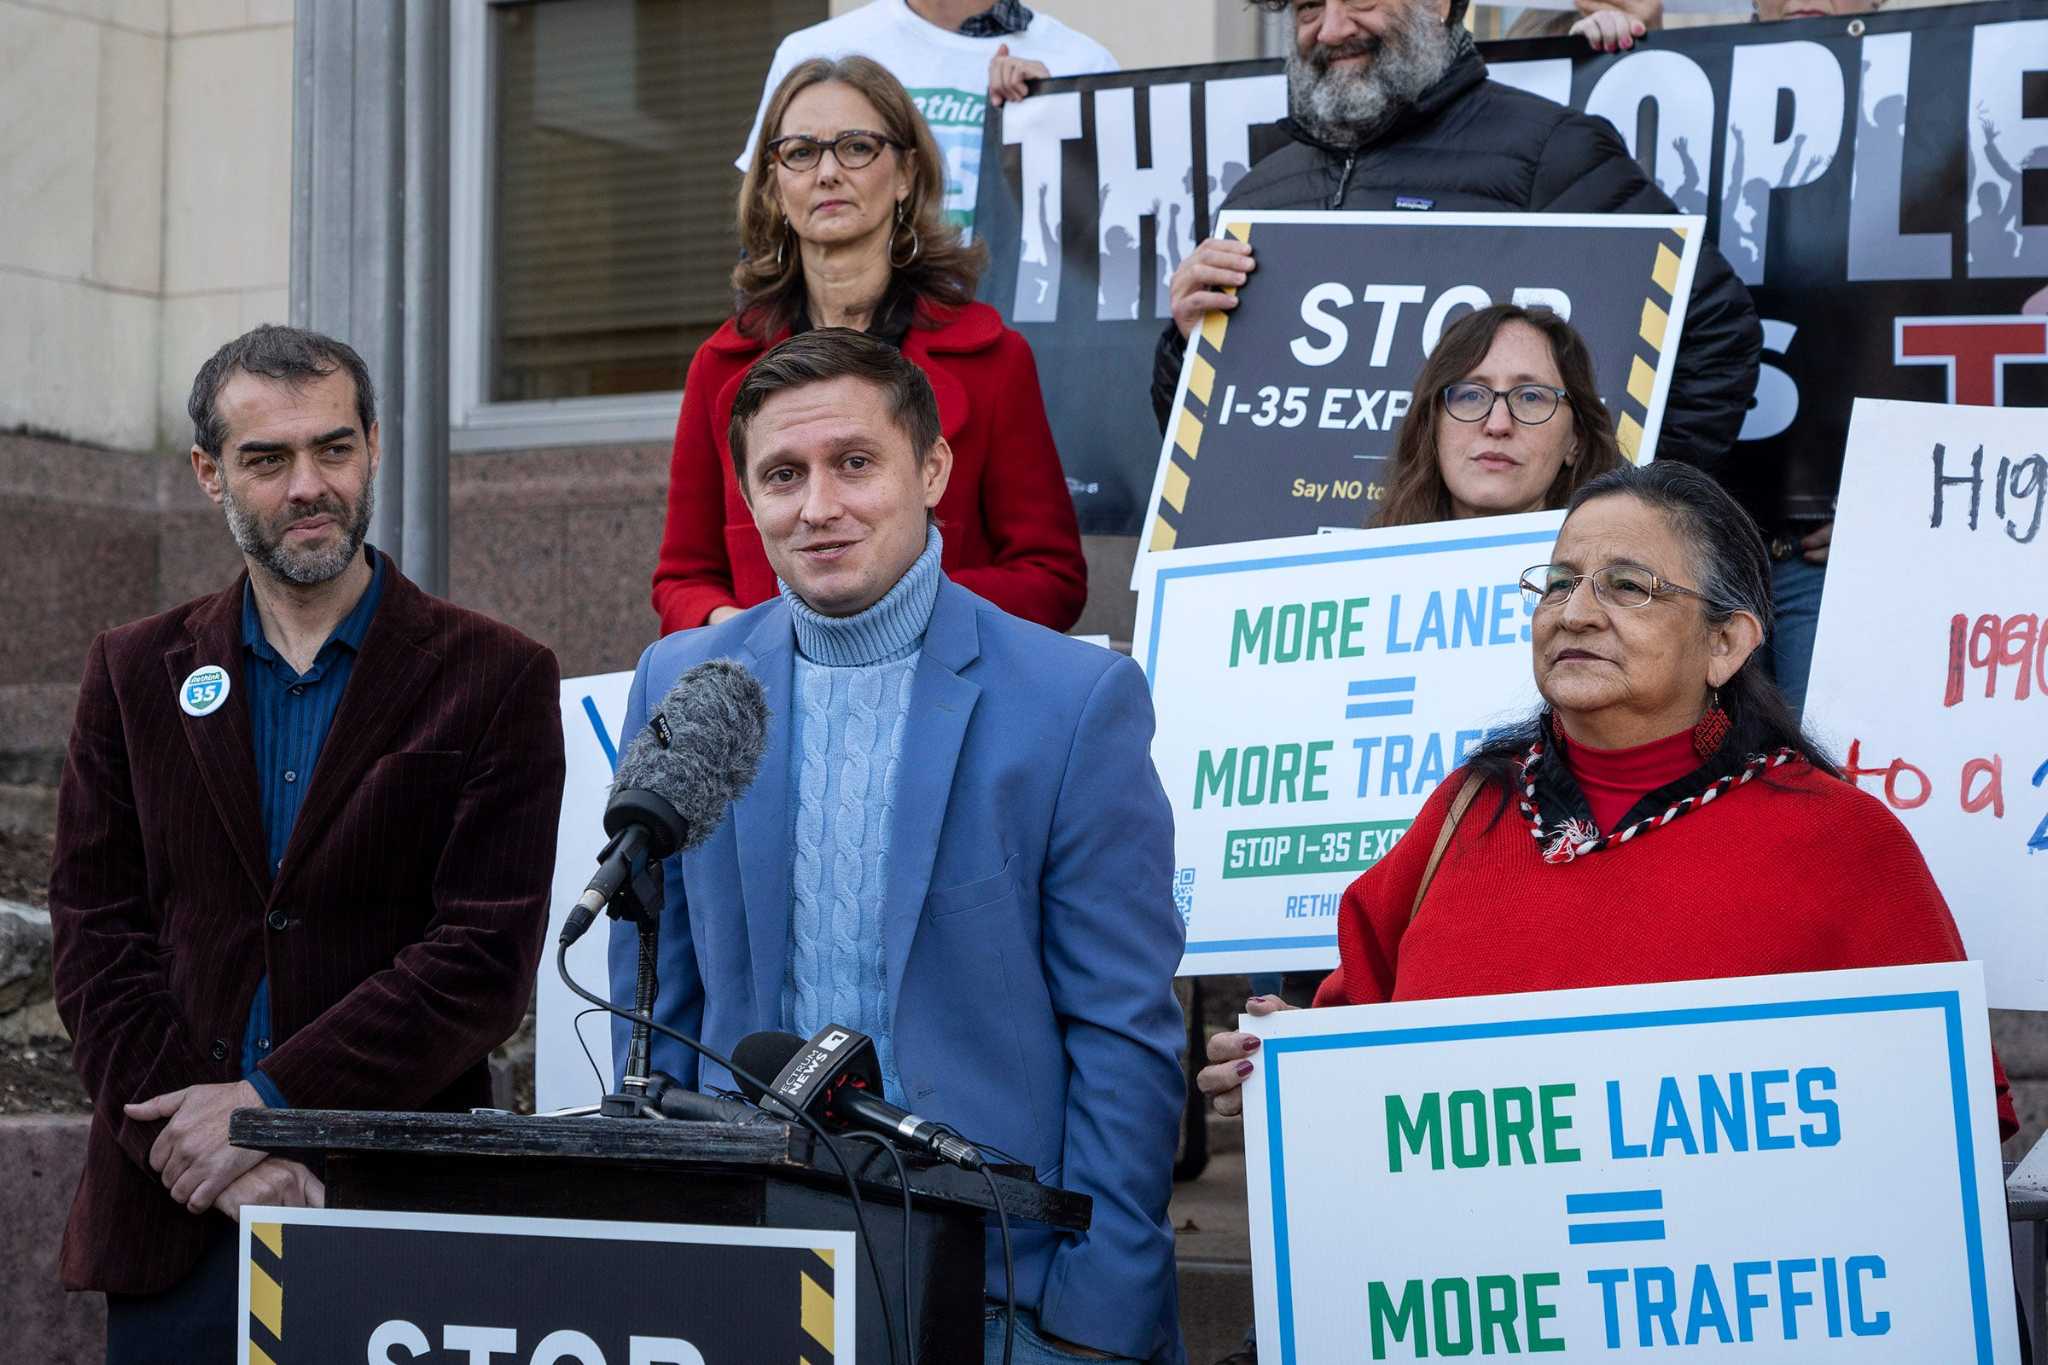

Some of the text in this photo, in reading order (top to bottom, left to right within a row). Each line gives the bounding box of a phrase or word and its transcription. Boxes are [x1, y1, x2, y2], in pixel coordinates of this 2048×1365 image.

[1487, 21, 2048, 286] OPLE
[1002, 75, 1288, 321] THE
[1219, 385, 1310, 428] I-35
[1292, 478, 1327, 502] Say
[1332, 480, 1362, 500] NO
[1229, 597, 1371, 668] MORE
[191, 685, 217, 704] 35
[1193, 726, 1500, 810] MORE TRAF
[1848, 738, 1932, 810] to
[1960, 754, 2004, 819] a
[1230, 835, 1292, 869] STOP
[1298, 832, 1352, 865] I-35
[1286, 894, 1345, 918] RETHI
[788, 1051, 829, 1095] NEWS
[1384, 1066, 1842, 1173] MORE LANES
[1368, 1255, 1892, 1361] MORE TRAFFIC
